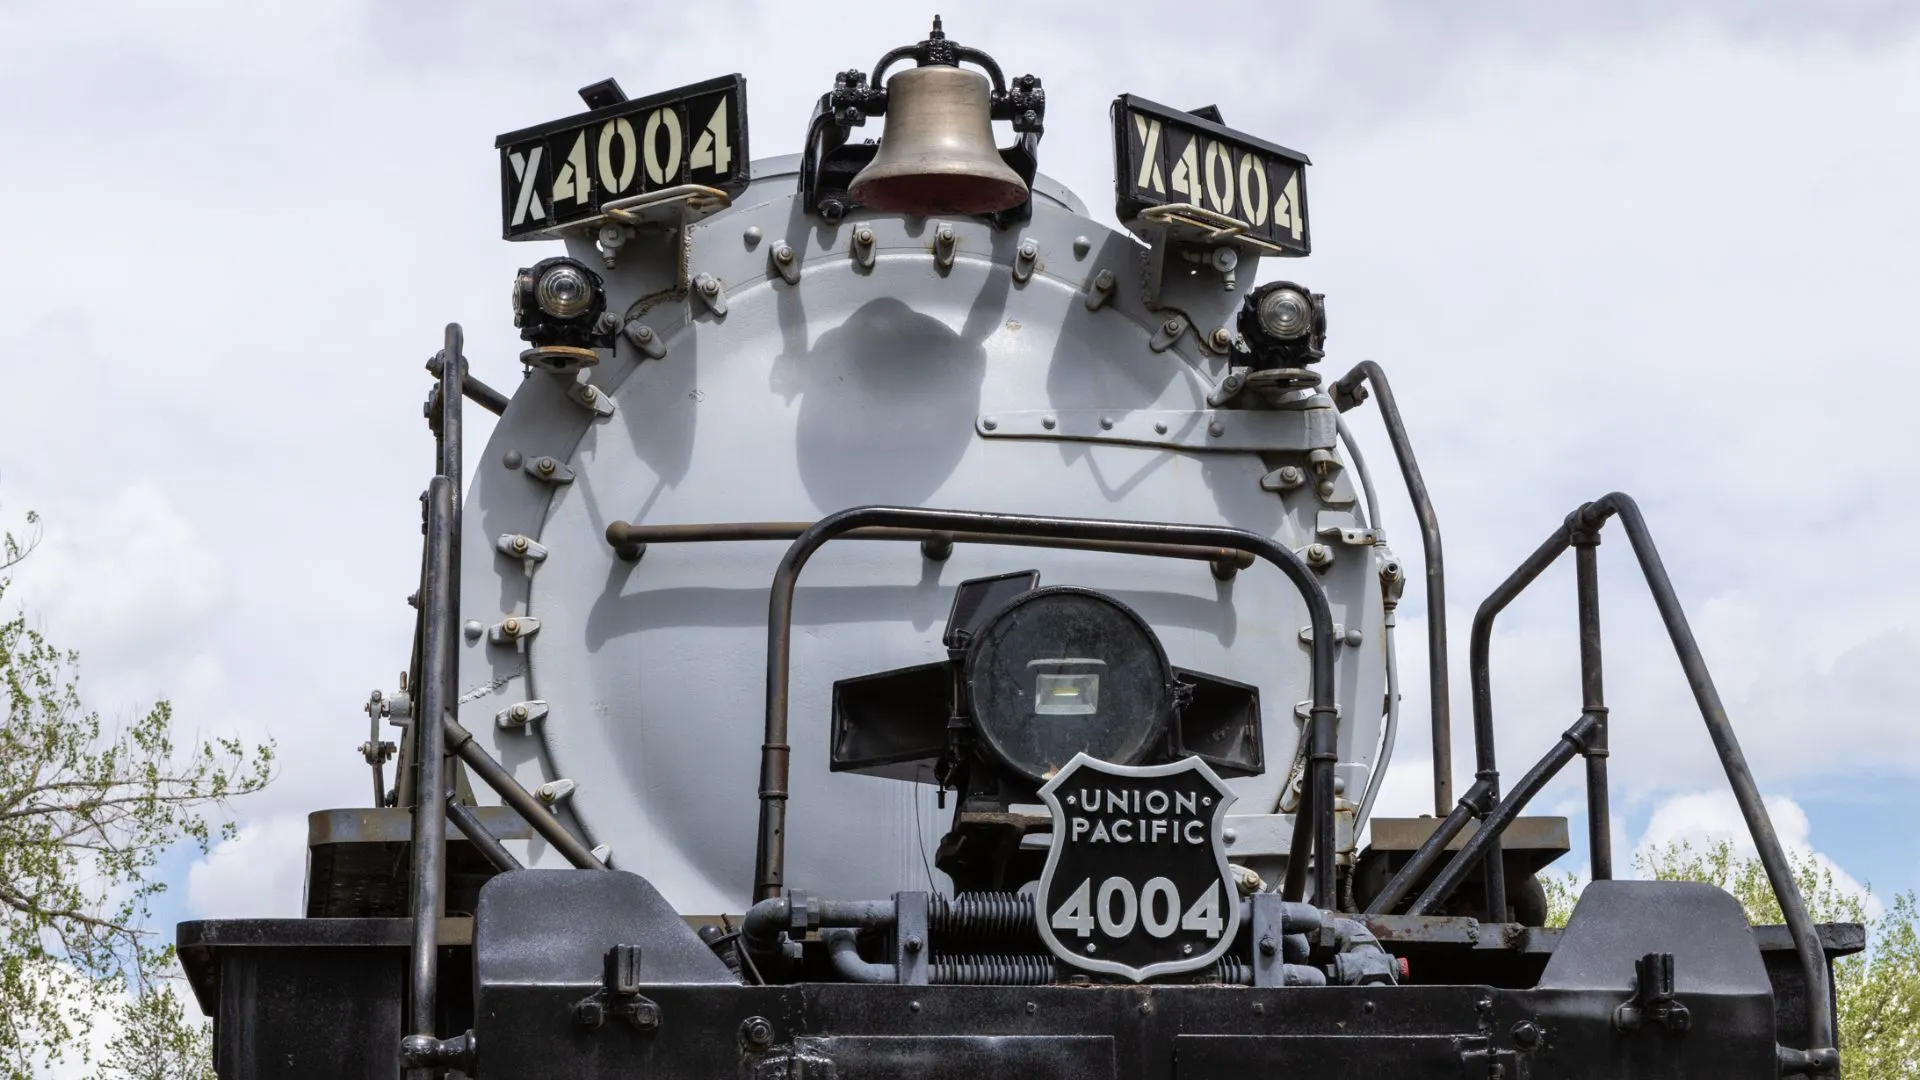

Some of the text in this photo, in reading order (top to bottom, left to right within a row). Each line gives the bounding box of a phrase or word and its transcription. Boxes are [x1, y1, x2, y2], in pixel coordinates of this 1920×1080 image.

[1080, 788, 1197, 815] UNION
[1071, 817, 1205, 845] PACIFIC
[1052, 876, 1223, 939] 4004
